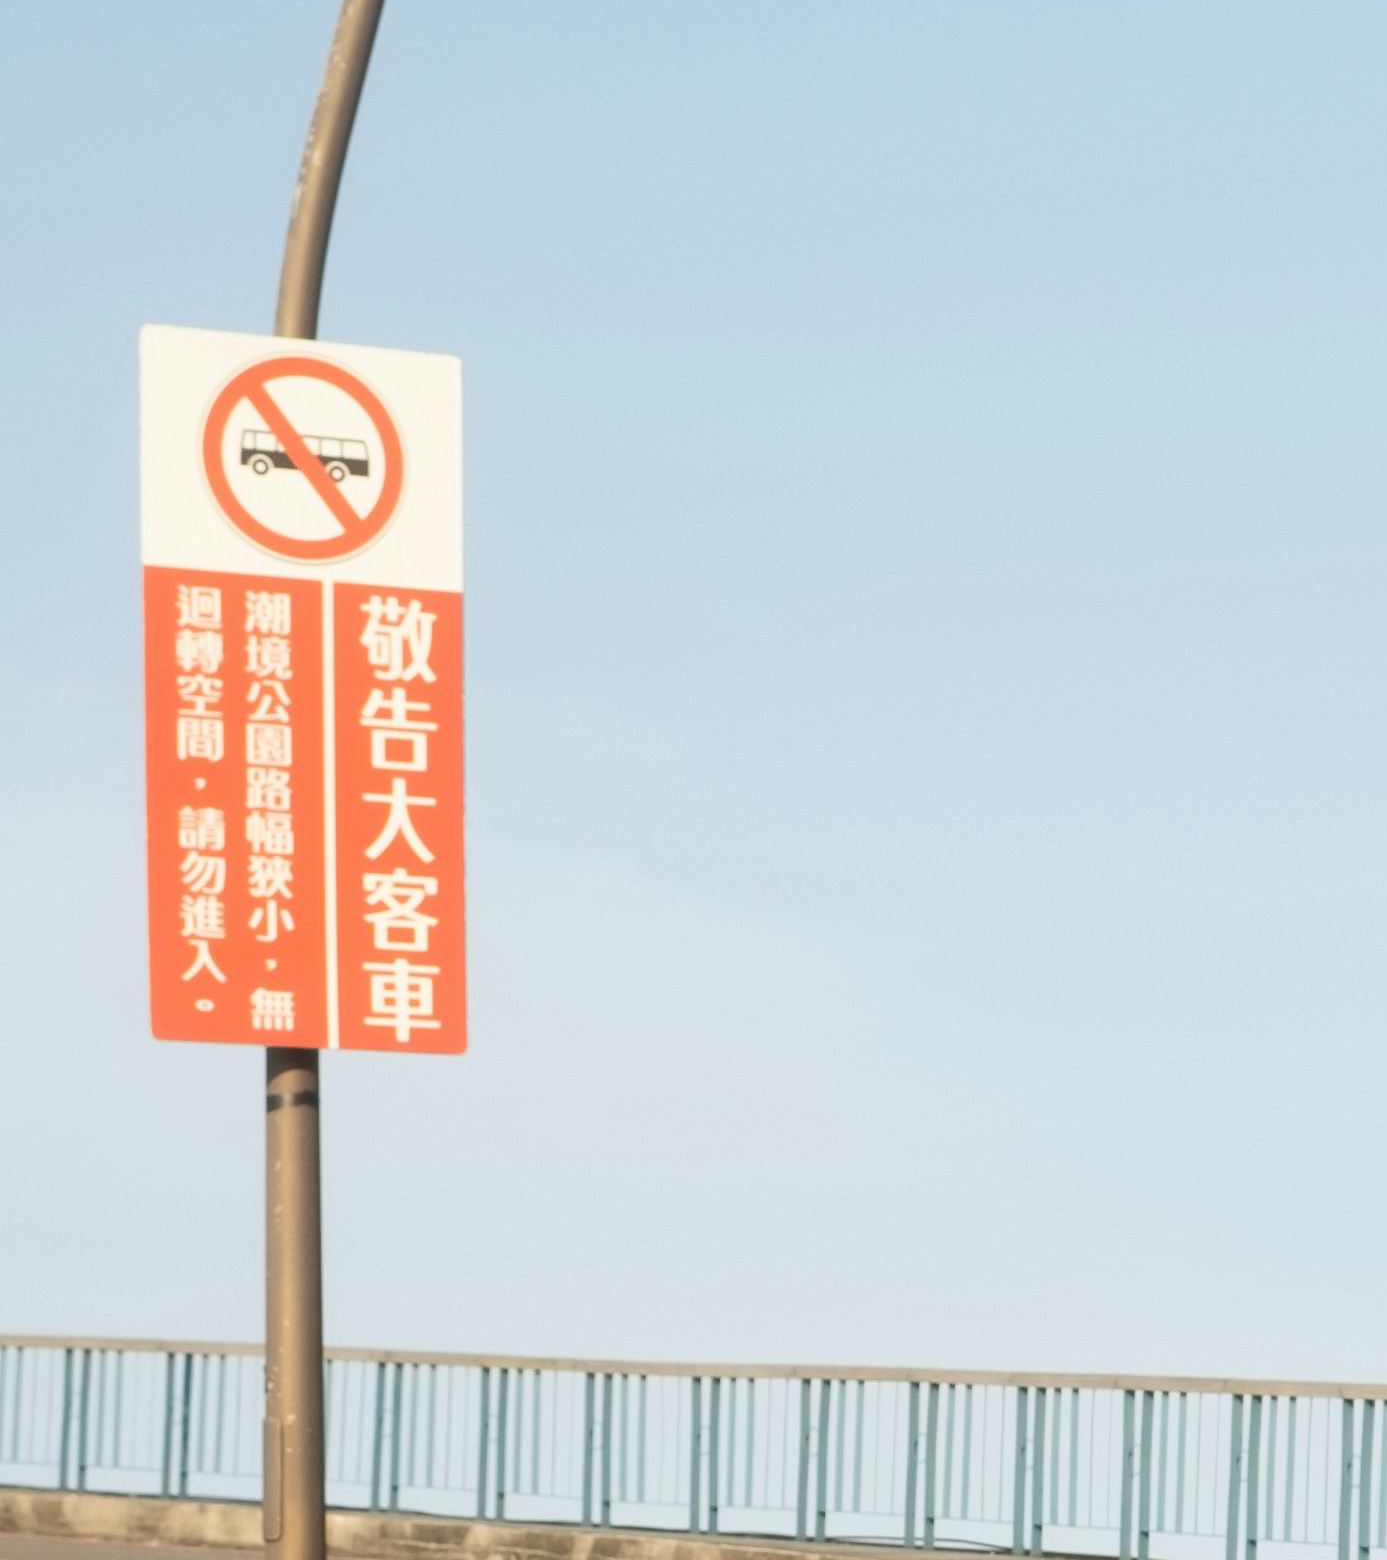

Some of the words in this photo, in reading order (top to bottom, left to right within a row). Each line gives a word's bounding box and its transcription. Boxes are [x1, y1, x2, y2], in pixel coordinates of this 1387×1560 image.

[359, 595, 441, 1043] 敬告大客車
